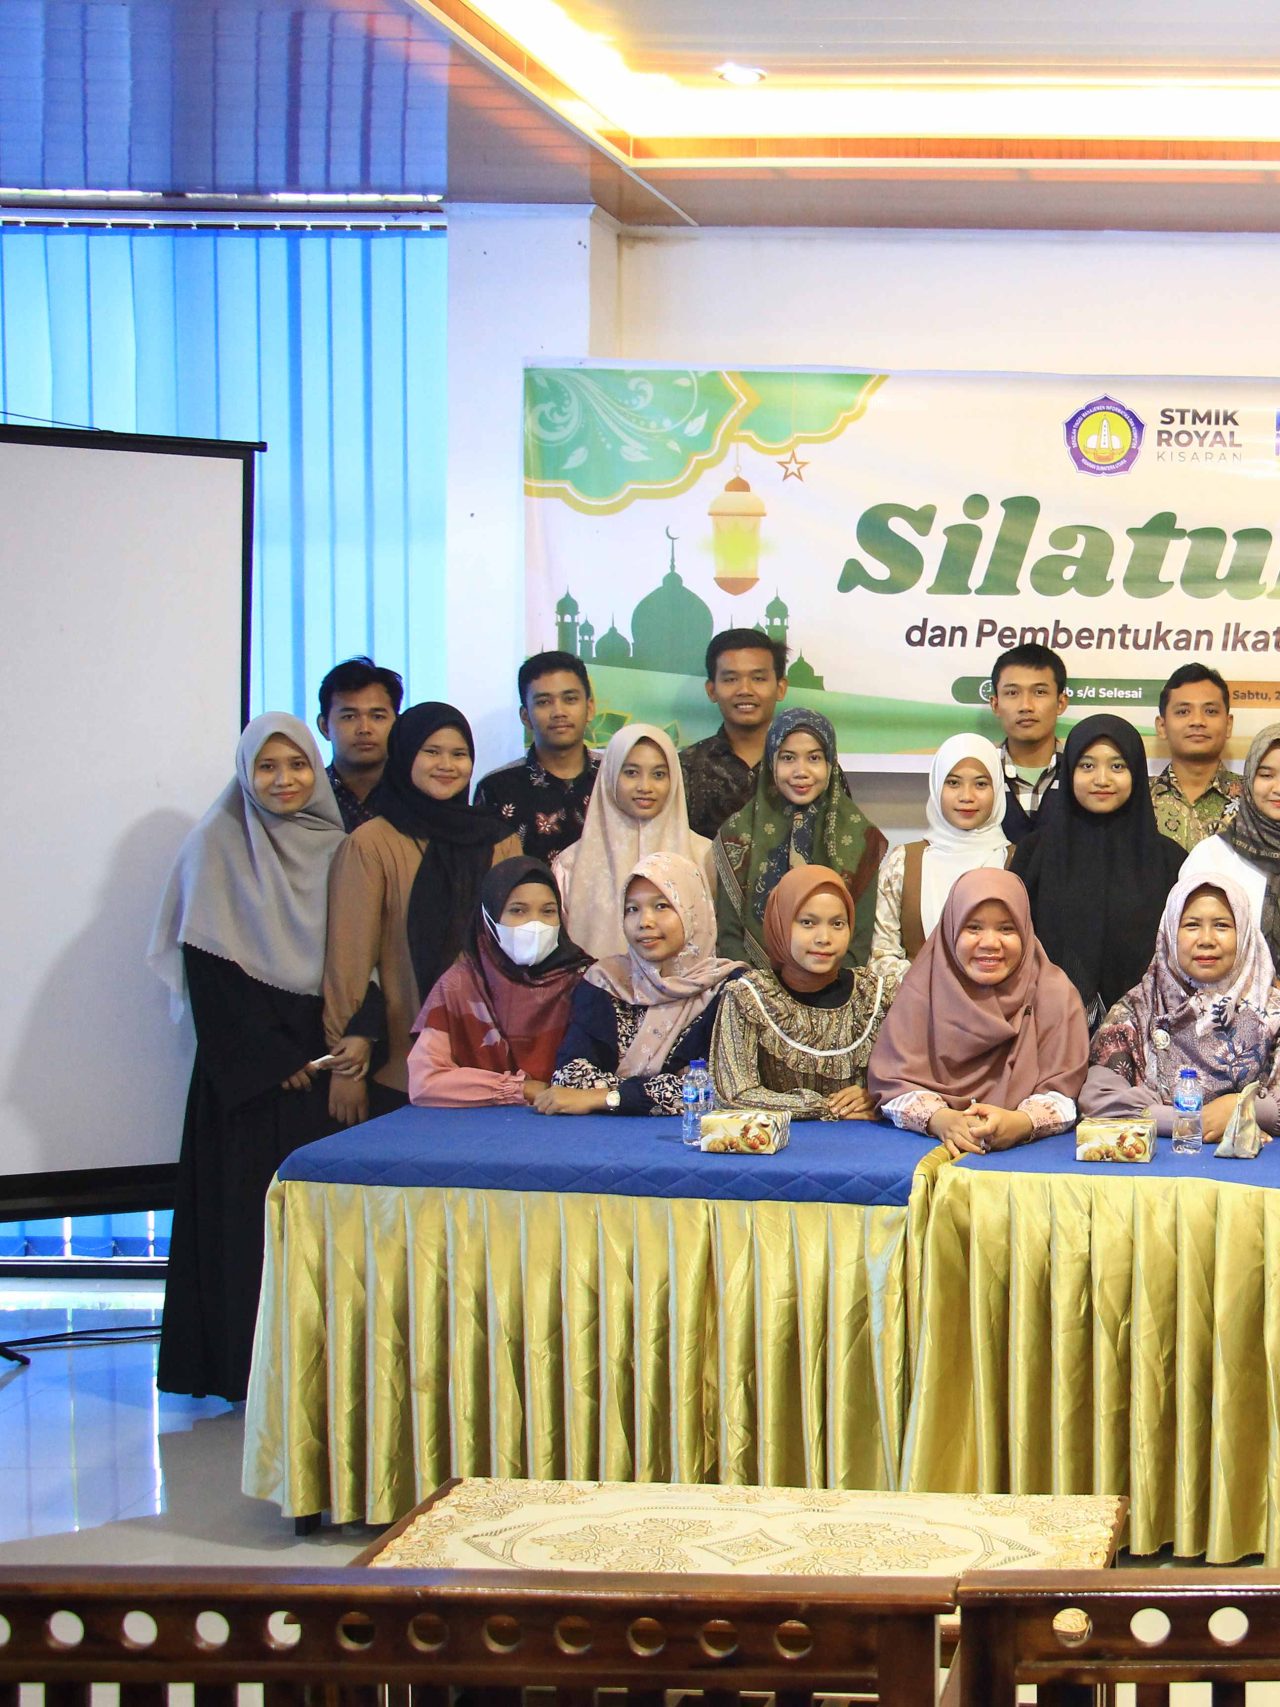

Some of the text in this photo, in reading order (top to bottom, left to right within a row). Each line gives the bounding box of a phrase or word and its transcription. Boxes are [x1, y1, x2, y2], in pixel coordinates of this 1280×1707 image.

[1160, 408, 1240, 426] STMIK
[1157, 430, 1242, 448] ROYAL
[1157, 451, 1242, 463] KISARAN
[905, 618, 967, 648] dan
[976, 619, 1213, 651] Pembentukan
[1077, 686, 1096, 699] s/d
[1098, 687, 1143, 699] Selesai
[1232, 690, 1272, 702] Sabtu,
